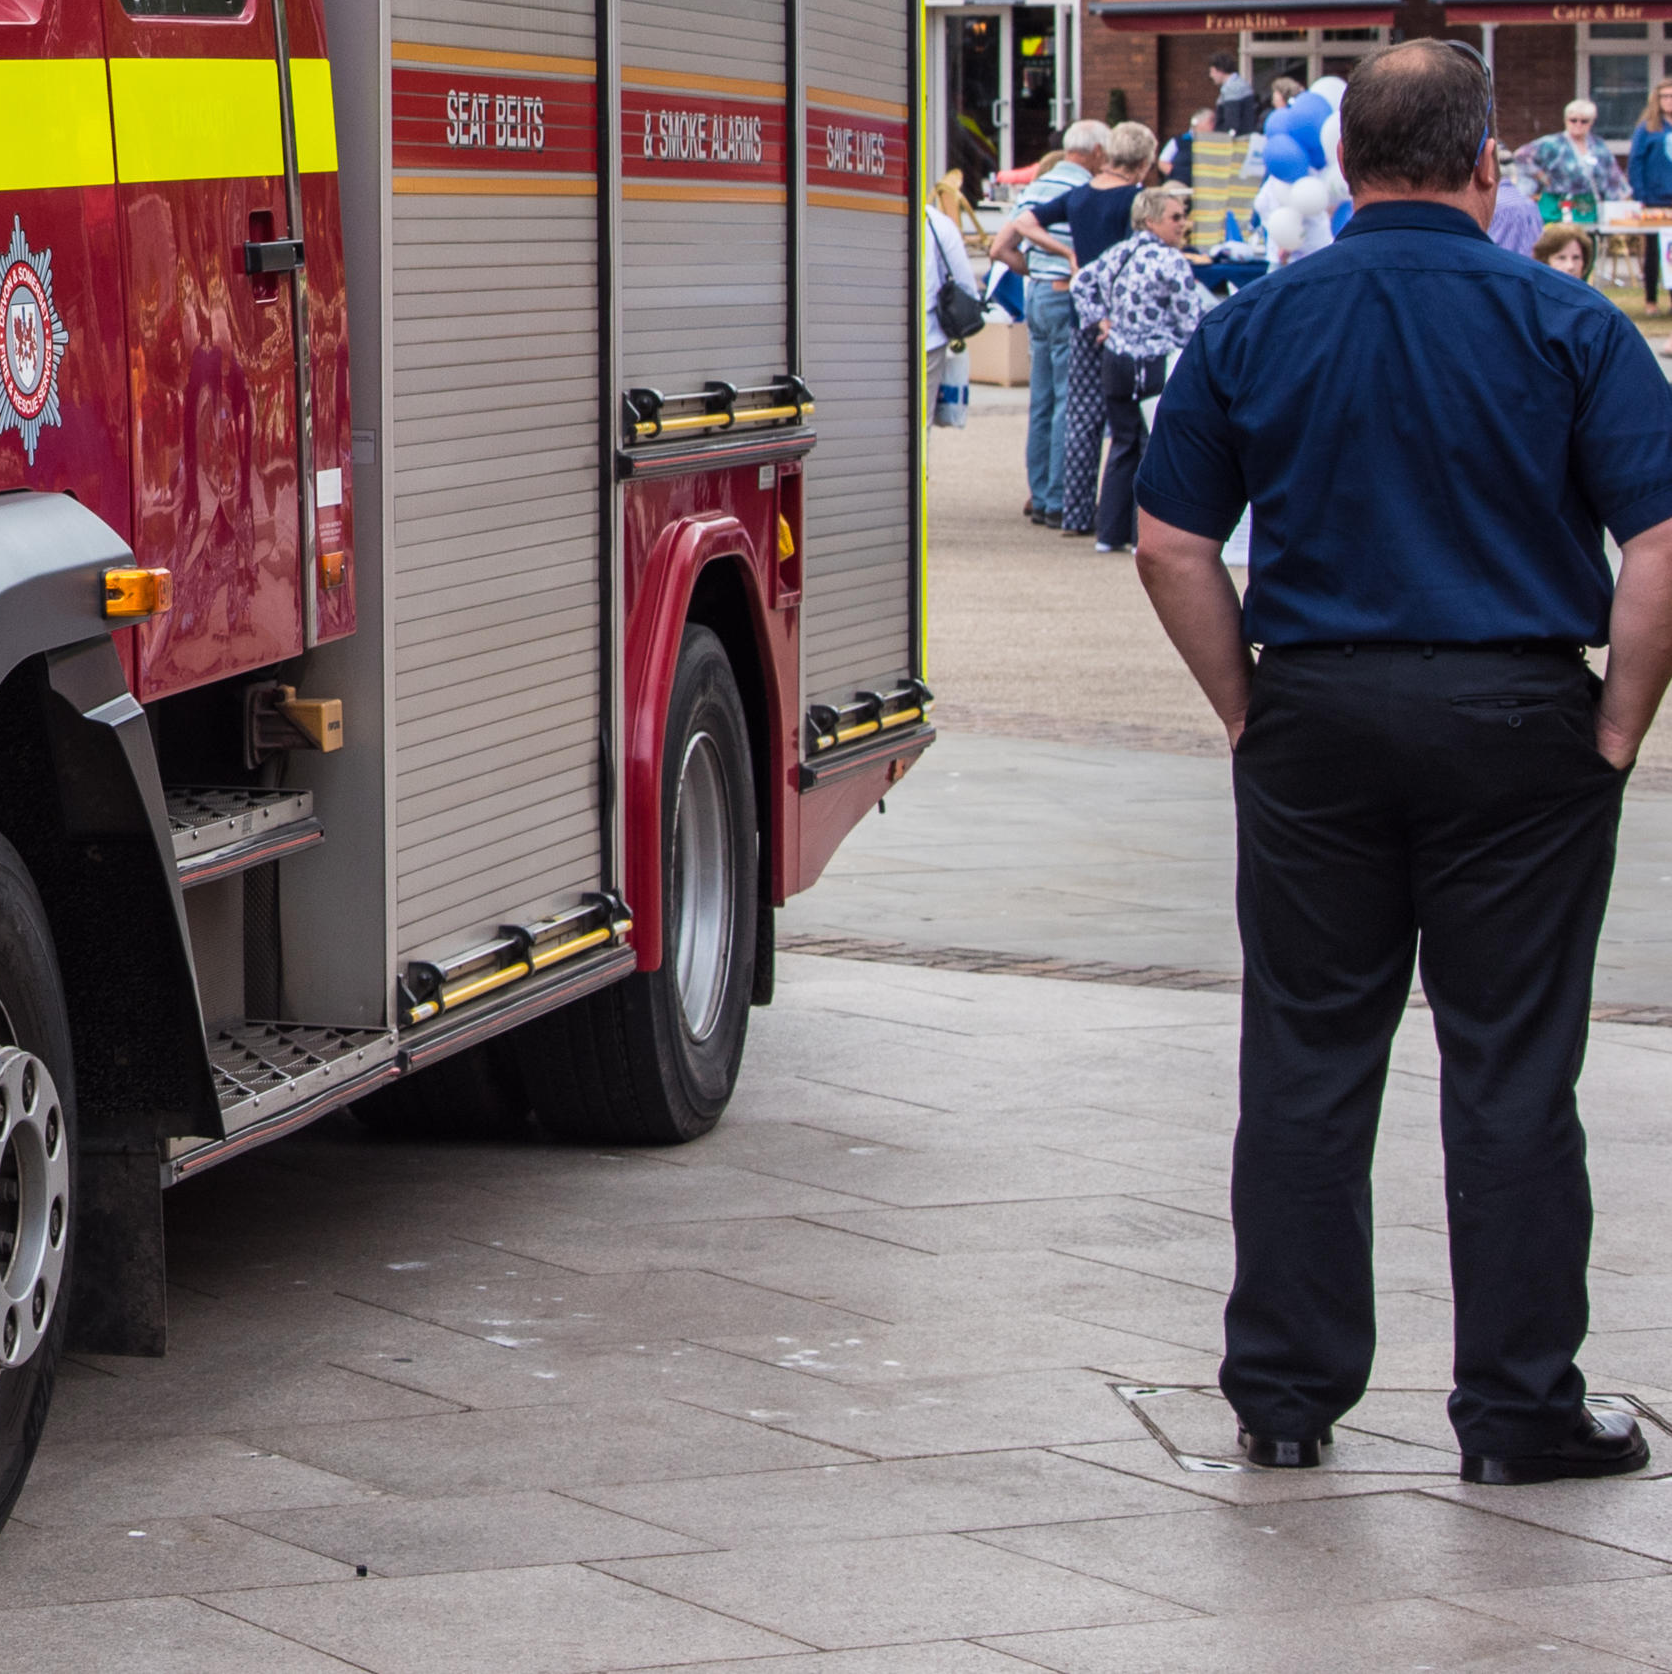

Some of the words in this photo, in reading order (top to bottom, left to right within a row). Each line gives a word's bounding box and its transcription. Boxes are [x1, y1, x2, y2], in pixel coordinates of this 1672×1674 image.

[1205, 12, 1288, 30] Franklins
[1613, 4, 1643, 19] Bar
[447, 89, 489, 149] SEAT
[495, 94, 545, 153] BELTS
[643, 109, 653, 161] &
[659, 109, 708, 161] SMOKE
[711, 114, 762, 164] ALARMS
[826, 124, 854, 171] SAVE
[857, 130, 886, 176] LIVES
[18, 266, 50, 323] SOMERSET
[0, 342, 11, 383] FIRE
[13, 393, 41, 415] RESCUE
[37, 338, 52, 402] SERVICE
